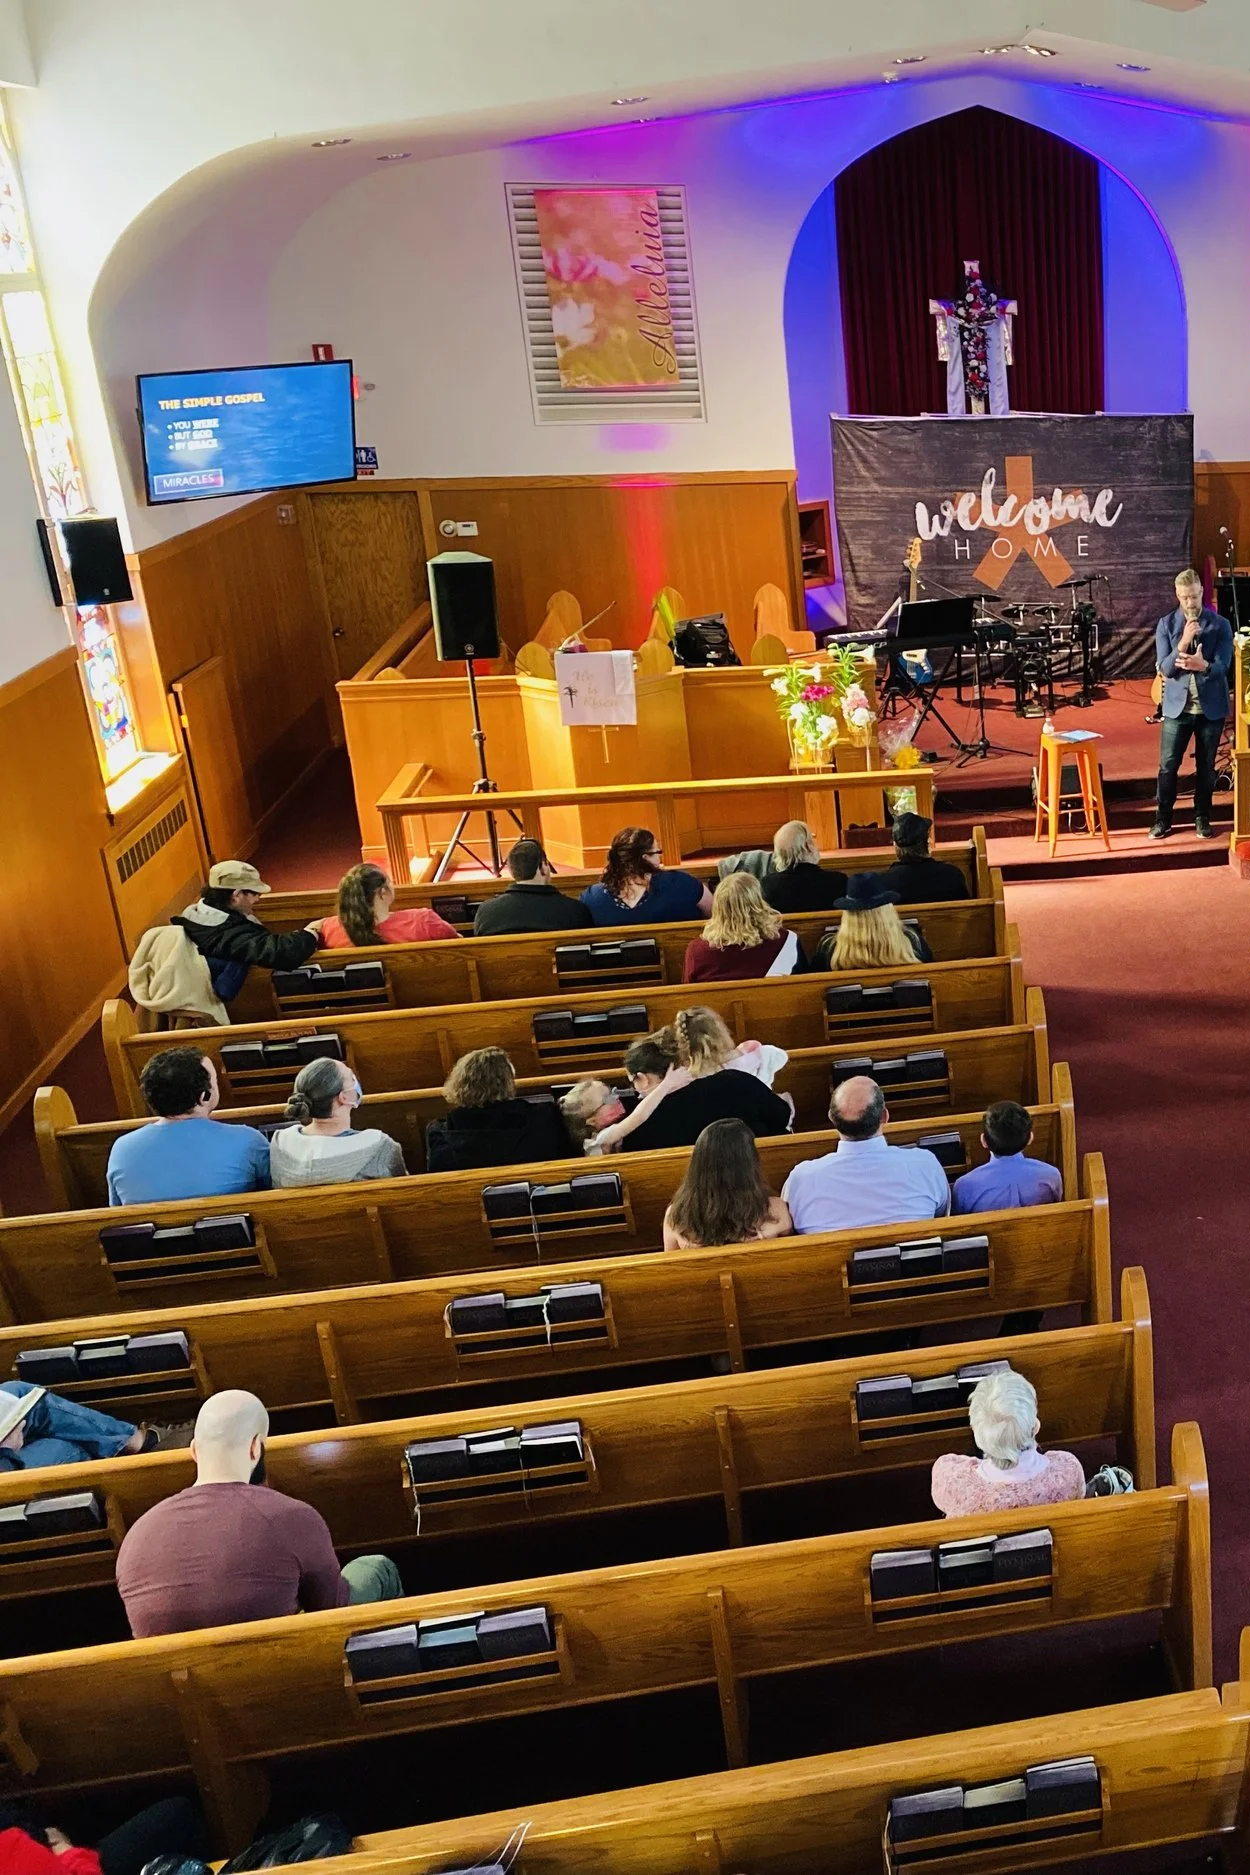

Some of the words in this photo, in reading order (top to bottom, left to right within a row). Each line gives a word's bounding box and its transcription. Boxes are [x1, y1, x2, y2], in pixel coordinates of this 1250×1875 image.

[630, 203, 677, 375] Alleluia
[158, 399, 181, 410] THE
[182, 395, 223, 409] SIMPLE
[225, 392, 265, 405] GOSPEL
[173, 420, 191, 430] YOU
[174, 431, 191, 440] BUT
[163, 473, 215, 488] MIRACLES
[915, 467, 1124, 541] welcome
[954, 535, 1090, 560] HOME
